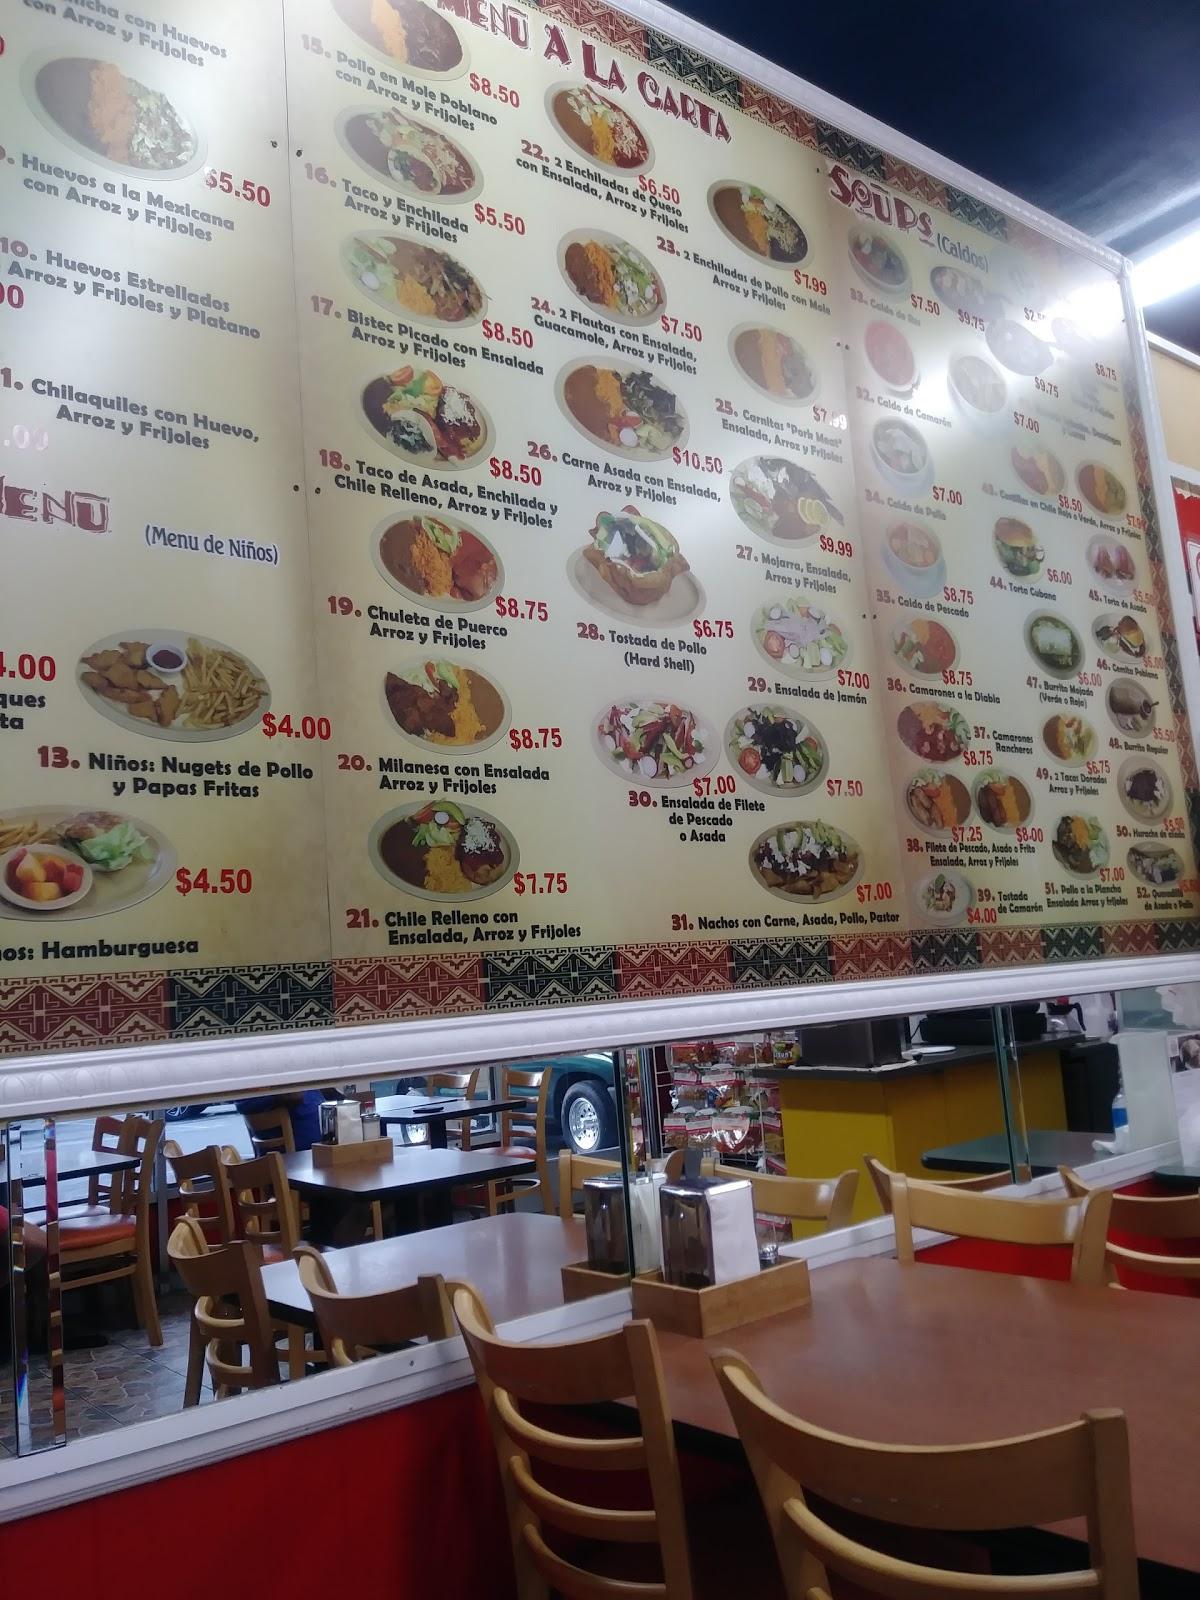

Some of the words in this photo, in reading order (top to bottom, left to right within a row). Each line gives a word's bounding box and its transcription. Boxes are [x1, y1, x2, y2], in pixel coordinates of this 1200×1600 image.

[163, 24, 228, 58] Huevos
[301, 34, 332, 59] 15.
[336, 50, 376, 76] Pollo
[402, 76, 436, 100] Mole
[440, 92, 498, 126] Poblano
[469, 72, 520, 109] $8.50
[204, 167, 271, 208] $5.50
[521, 139, 550, 163] 22.
[565, 159, 629, 195] Enchiladas
[649, 196, 683, 218] Queso
[638, 174, 680, 205] $6.50
[22, 153, 97, 189] Huevos
[147, 191, 235, 231] Mexicana
[304, 163, 337, 188] 16.
[342, 178, 379, 202] Taco
[396, 197, 469, 234] Enchilada
[542, 165, 602, 200] Ensalada,
[605, 191, 637, 213] Arroz
[650, 208, 689, 234] Frijoles
[474, 202, 526, 236] $5.50
[937, 233, 989, 273] (Caldos)
[656, 235, 681, 257] 23.
[693, 252, 748, 284] Enchiladas
[764, 280, 789, 300] Pollo
[46, 249, 121, 283] Huevos
[127, 271, 230, 313] Estrellados
[793, 269, 827, 296] $7.99
[8, 261, 68, 289] Arroz
[92, 281, 164, 313] Frijoles
[187, 307, 261, 340] Platano
[911, 294, 940, 316] $7.50
[530, 296, 556, 316] 24.
[570, 311, 616, 335] Flautas
[642, 333, 697, 363] Ensalada,
[660, 314, 702, 342] $7.50
[958, 308, 985, 332] $9.75
[310, 295, 342, 319] 17.
[347, 308, 394, 334] Bistec
[398, 322, 449, 349] Picado
[481, 346, 544, 376] Ensalada
[481, 318, 534, 349] $8.50
[534, 315, 609, 350] Guacamole,
[612, 339, 645, 359] Arroz
[658, 356, 697, 376] Frijoles
[31, 378, 148, 417] Chilaquiles
[193, 412, 259, 443] Huevo,
[715, 397, 738, 417] 25.
[743, 409, 784, 431] Carnitas
[1013, 411, 1040, 434] $7.00
[722, 418, 772, 444] Ensalada,
[774, 435, 800, 451] Arroz
[489, 457, 542, 487] $8.50
[527, 441, 558, 462] 26.
[562, 453, 600, 472] Carne
[603, 462, 641, 482] Asada
[667, 477, 721, 503] Ensalada,
[672, 446, 723, 475] $10.50
[319, 448, 351, 472] 18.
[356, 460, 393, 481] Taco
[421, 474, 473, 498] Asada,
[477, 485, 546, 511] Enchilada
[334, 474, 376, 495] Chile
[381, 484, 443, 510] Relleno,
[447, 497, 488, 516] Arroz
[504, 507, 553, 529] Frijoles
[933, 486, 963, 506] $7.00
[1058, 494, 1083, 513] $8.50
[145, 524, 199, 552] (Menu
[229, 539, 279, 566] Niños)
[820, 534, 853, 558] $9.99
[736, 544, 759, 562] 27.
[761, 552, 804, 574] Mojarra,
[806, 562, 851, 583] Ensalada,
[1047, 568, 1073, 586] $6.00
[898, 596, 922, 610] Caldo
[943, 586, 974, 605] $8.75
[328, 595, 362, 617] 19.
[367, 605, 430, 626] Chuleta
[457, 617, 508, 637] Puerco
[495, 595, 549, 622] $8.75
[577, 622, 605, 642] 28.
[608, 630, 658, 648] Tostada
[678, 640, 707, 655] Pollo
[693, 619, 734, 639] $6.75
[623, 651, 660, 669] (Hard
[662, 656, 696, 674] Shell)
[747, 676, 773, 693] 29.
[775, 683, 821, 700] Ensalada
[837, 669, 871, 690] $7.00
[887, 677, 907, 693] 36.
[909, 683, 955, 698] Camarones
[941, 669, 973, 687] $8.75
[262, 712, 331, 740] $4.00
[974, 727, 990, 740] 37.
[993, 730, 1033, 743] Camarones
[509, 728, 563, 752] $8.75
[996, 742, 1033, 755] Rancheros
[37, 746, 80, 769] 13.
[89, 752, 155, 773] Niños:
[162, 756, 232, 778] Nugets
[267, 761, 313, 779] Pollo
[337, 754, 373, 772] 20.
[379, 757, 450, 776] Milanesa
[484, 763, 550, 781] Ensalada
[963, 751, 993, 766] $8.75
[133, 777, 197, 797] Papas
[204, 780, 259, 798] Fritas
[692, 775, 736, 797] $7.00
[826, 779, 864, 797] $7.50
[628, 791, 658, 807] 30.
[661, 796, 715, 810] Ensalada
[734, 798, 765, 812] Filete
[686, 813, 733, 826] Pescado
[690, 829, 726, 842] Asada
[906, 838, 924, 852] 38.
[952, 827, 982, 842] $7.25
[1016, 827, 1043, 842] $8.00
[931, 855, 966, 867] Ensalada,
[176, 867, 252, 896] $4.50
[1100, 868, 1124, 882] $7.00
[856, 882, 892, 904] $7.00
[978, 888, 995, 902] 39.
[998, 891, 1028, 901] Tostada
[346, 908, 379, 928] 21.
[385, 910, 427, 928] Chile
[431, 910, 489, 926] Relleno
[671, 914, 694, 931] 31.
[698, 915, 739, 930] Nachos
[764, 914, 799, 927] Carne,
[802, 912, 837, 926] Asada,
[840, 912, 867, 925] Pollo,
[870, 912, 900, 924] Pastor
[967, 908, 997, 924] $4.00
[388, 927, 468, 945] Ensalada,
[473, 927, 514, 942] Arroz
[531, 924, 581, 940] Frijoles
[41, 938, 199, 962] Hamburguesa
